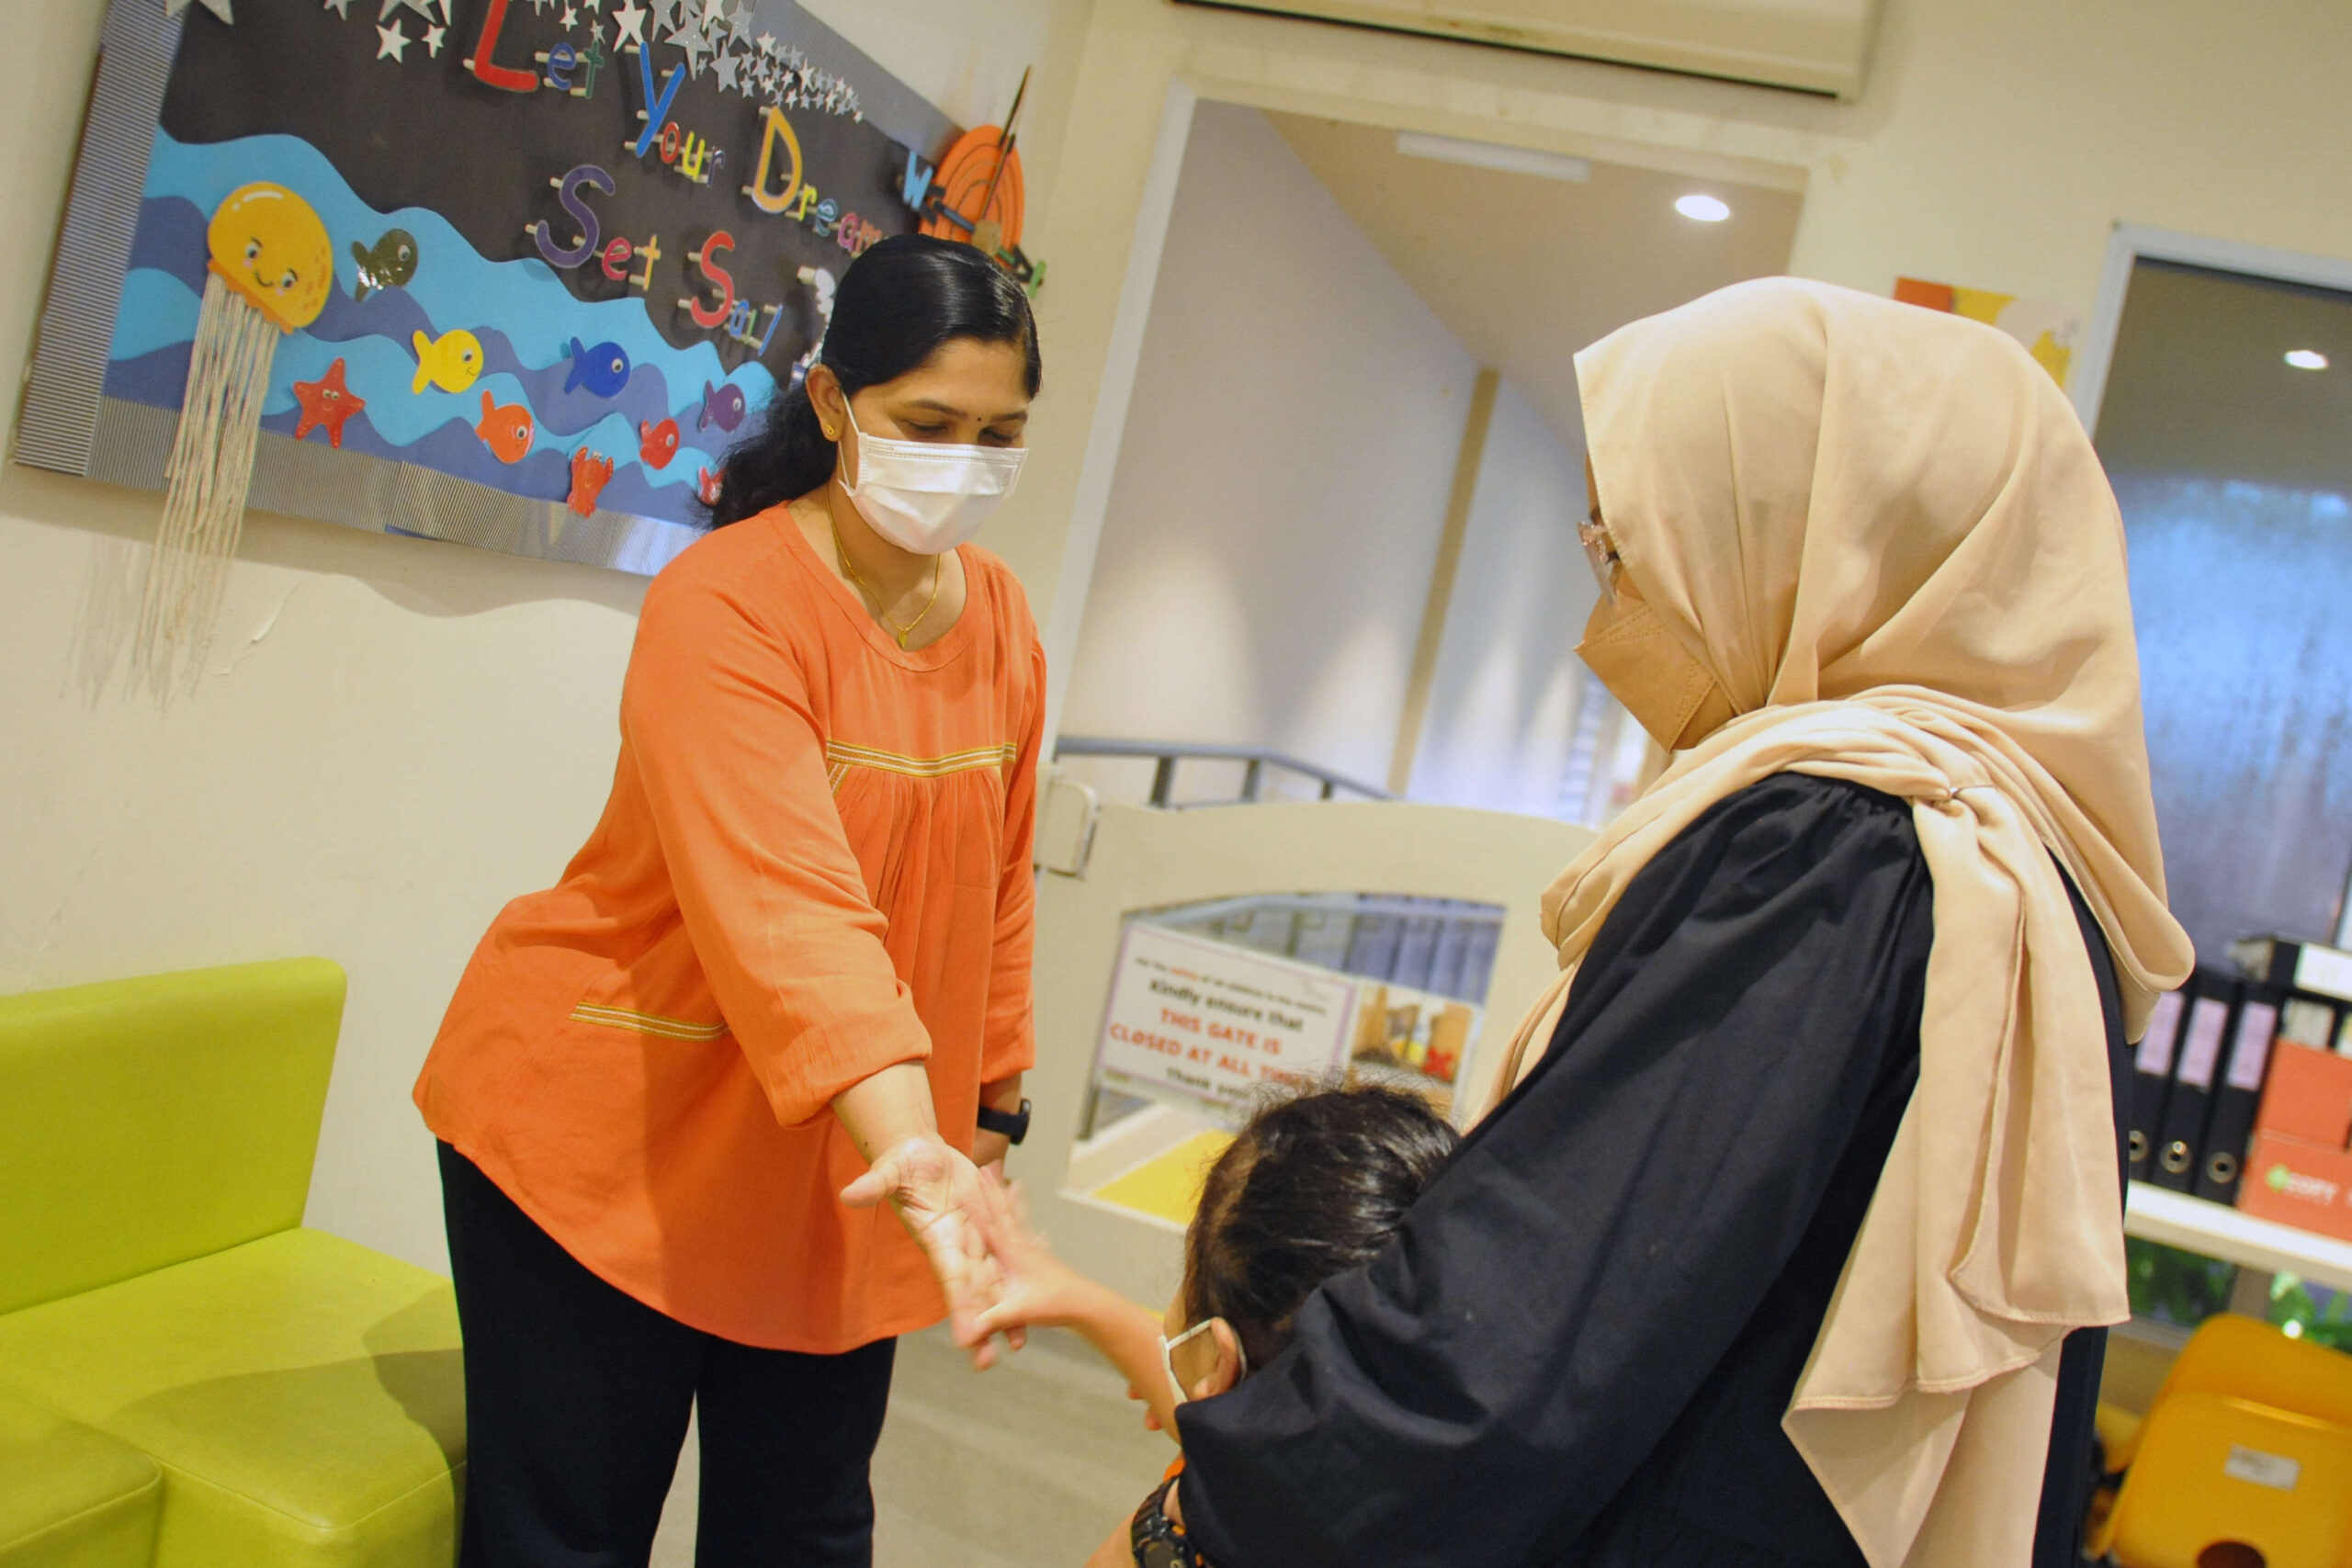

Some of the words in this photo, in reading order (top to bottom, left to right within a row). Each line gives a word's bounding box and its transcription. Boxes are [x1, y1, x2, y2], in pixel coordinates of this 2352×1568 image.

[473, 0, 605, 99] Let
[636, 41, 725, 188] Your
[534, 164, 661, 291] Set
[690, 231, 783, 356] Sail
[1151, 979, 1200, 1006] Kindly
[1205, 997, 1262, 1021] ensure
[1268, 1010, 1303, 1032] that
[1160, 1008, 1201, 1033] THIS
[1207, 1021, 1257, 1050] GATE
[1263, 1037, 1282, 1055] IS
[1109, 1021, 1182, 1056] CLOSED
[1187, 1046, 1212, 1065] AT
[1217, 1054, 1250, 1077] ALL
[1166, 1066, 1211, 1089] Thank
